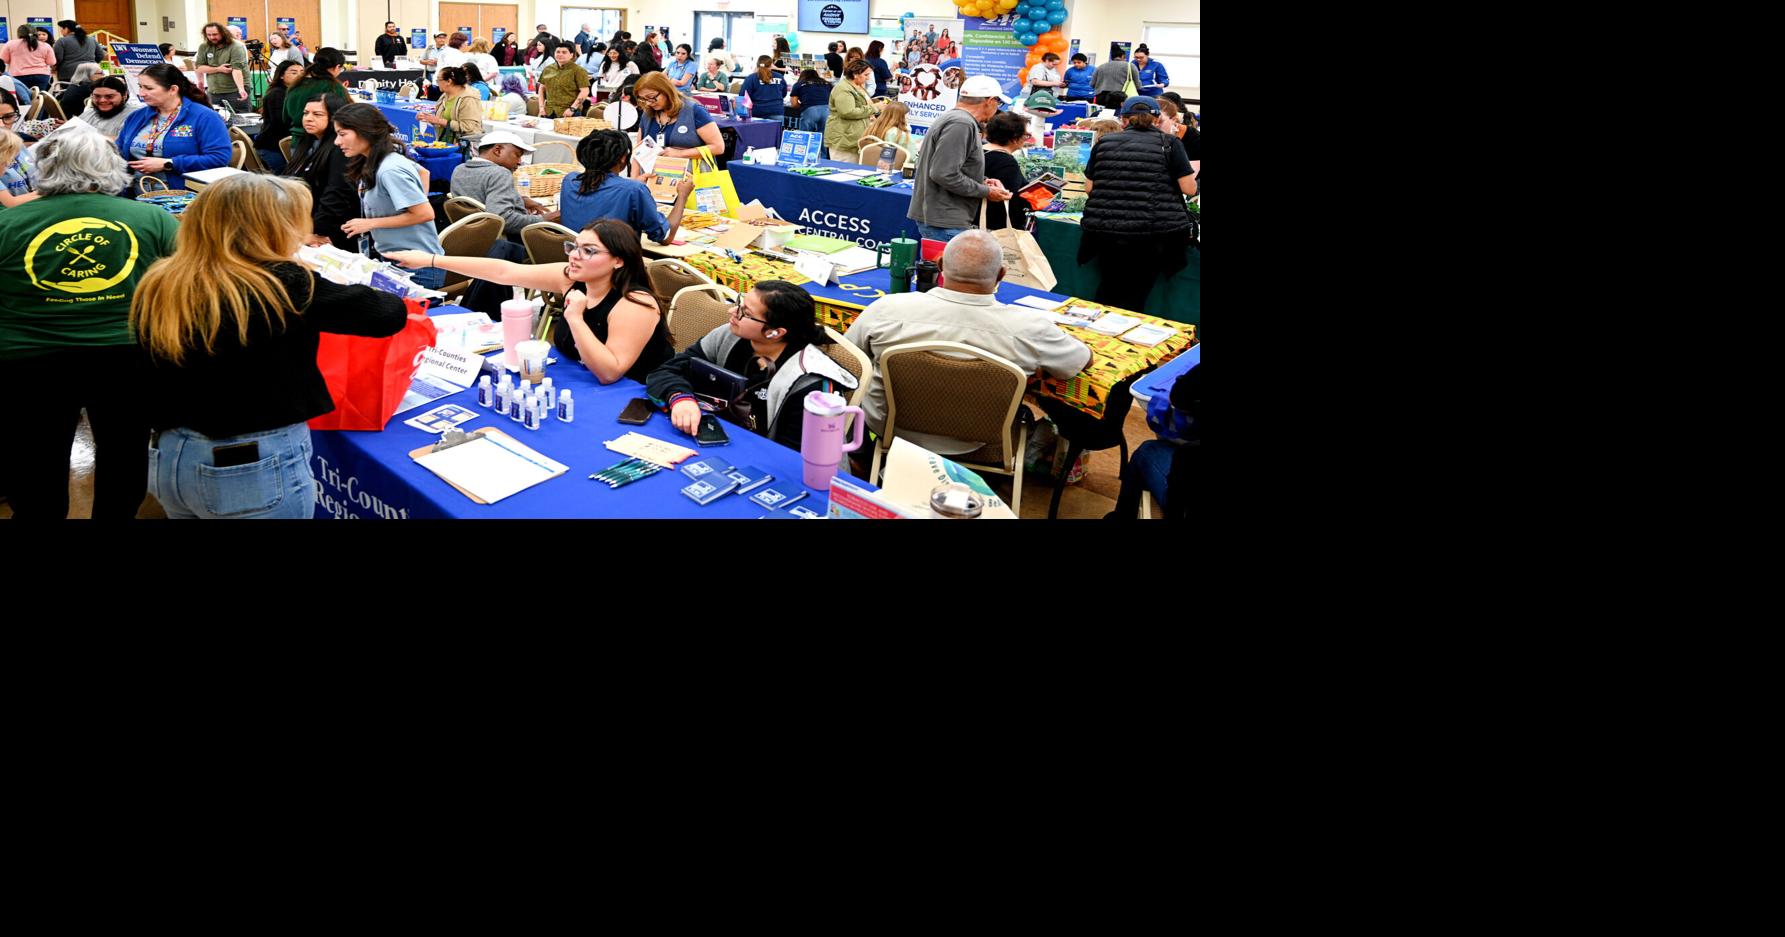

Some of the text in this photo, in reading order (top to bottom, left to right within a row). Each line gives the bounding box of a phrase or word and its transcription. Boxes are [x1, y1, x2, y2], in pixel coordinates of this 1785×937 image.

[135, 52, 162, 60] Defend
[798, 207, 871, 234] ACCESS
[55, 233, 111, 252] CIRCLE OF
[60, 263, 107, 278] CARING
[445, 363, 468, 375] Center
